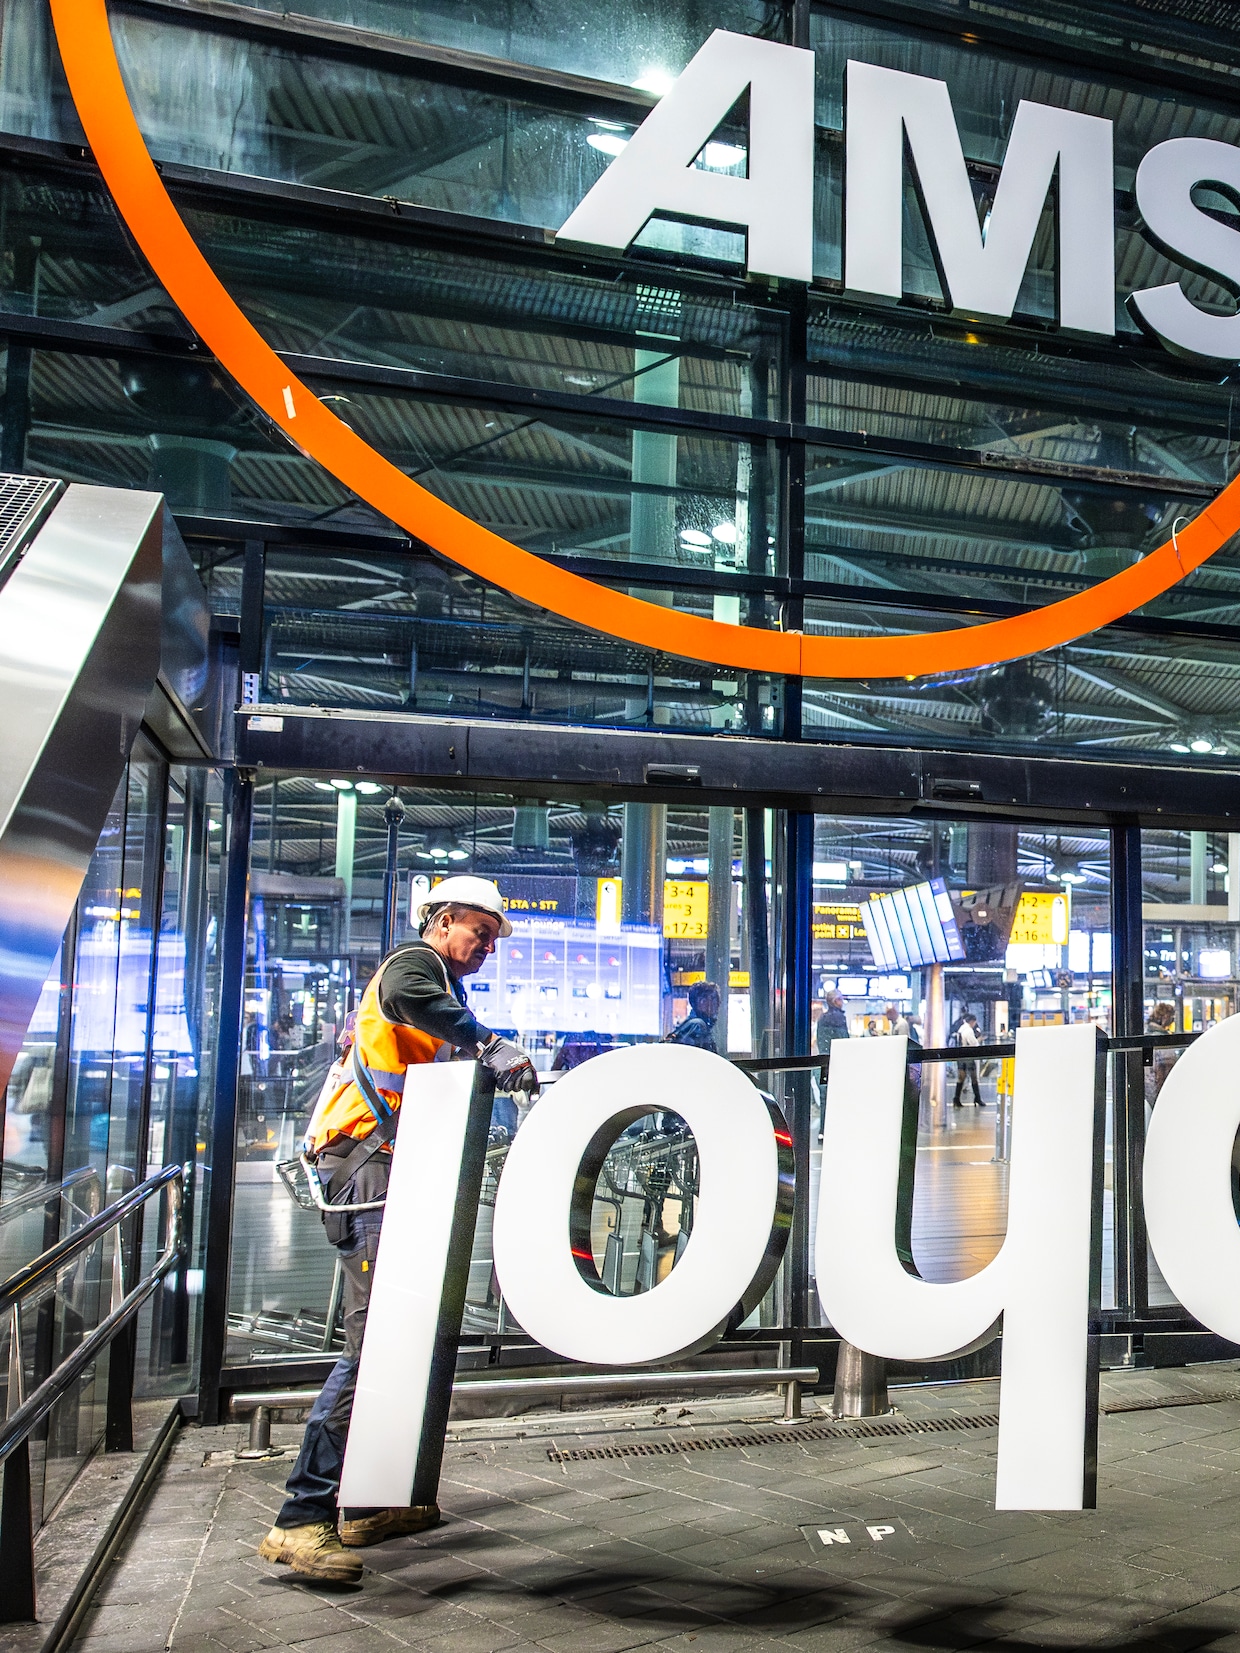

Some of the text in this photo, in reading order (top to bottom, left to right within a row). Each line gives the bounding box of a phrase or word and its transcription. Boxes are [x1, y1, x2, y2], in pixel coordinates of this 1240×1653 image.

[671, 885, 694, 898] 3-4
[510, 900, 529, 910] STA
[814, 905, 858, 915] Panorama
[1015, 931, 1038, 941] 1-16
[817, 1525, 895, 1545] N P
